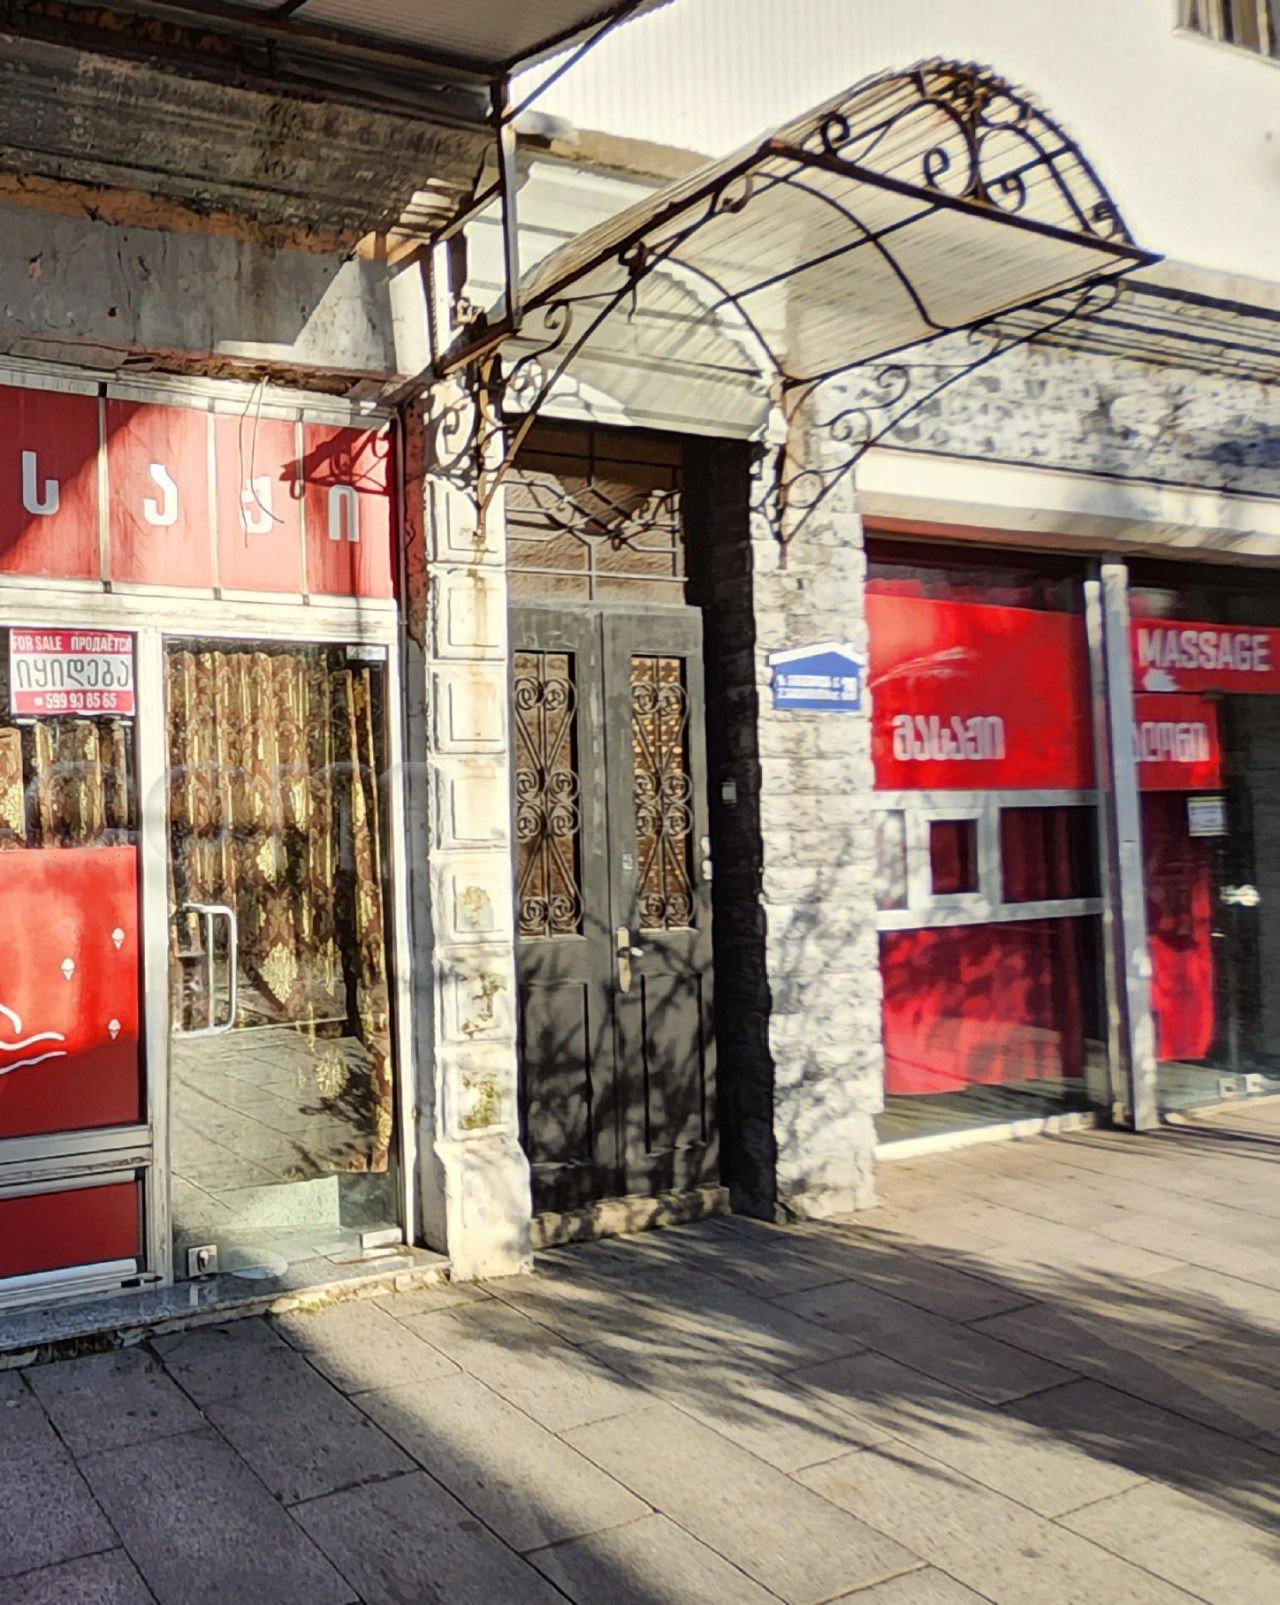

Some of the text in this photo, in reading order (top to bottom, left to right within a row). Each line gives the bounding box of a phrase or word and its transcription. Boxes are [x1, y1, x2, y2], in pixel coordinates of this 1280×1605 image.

[12, 635, 63, 651] FOR SALE
[1137, 628, 1273, 672] MASSAGE
[16, 658, 129, 689] იყიდება
[45, 692, 68, 709] 599
[69, 692, 84, 709] 93
